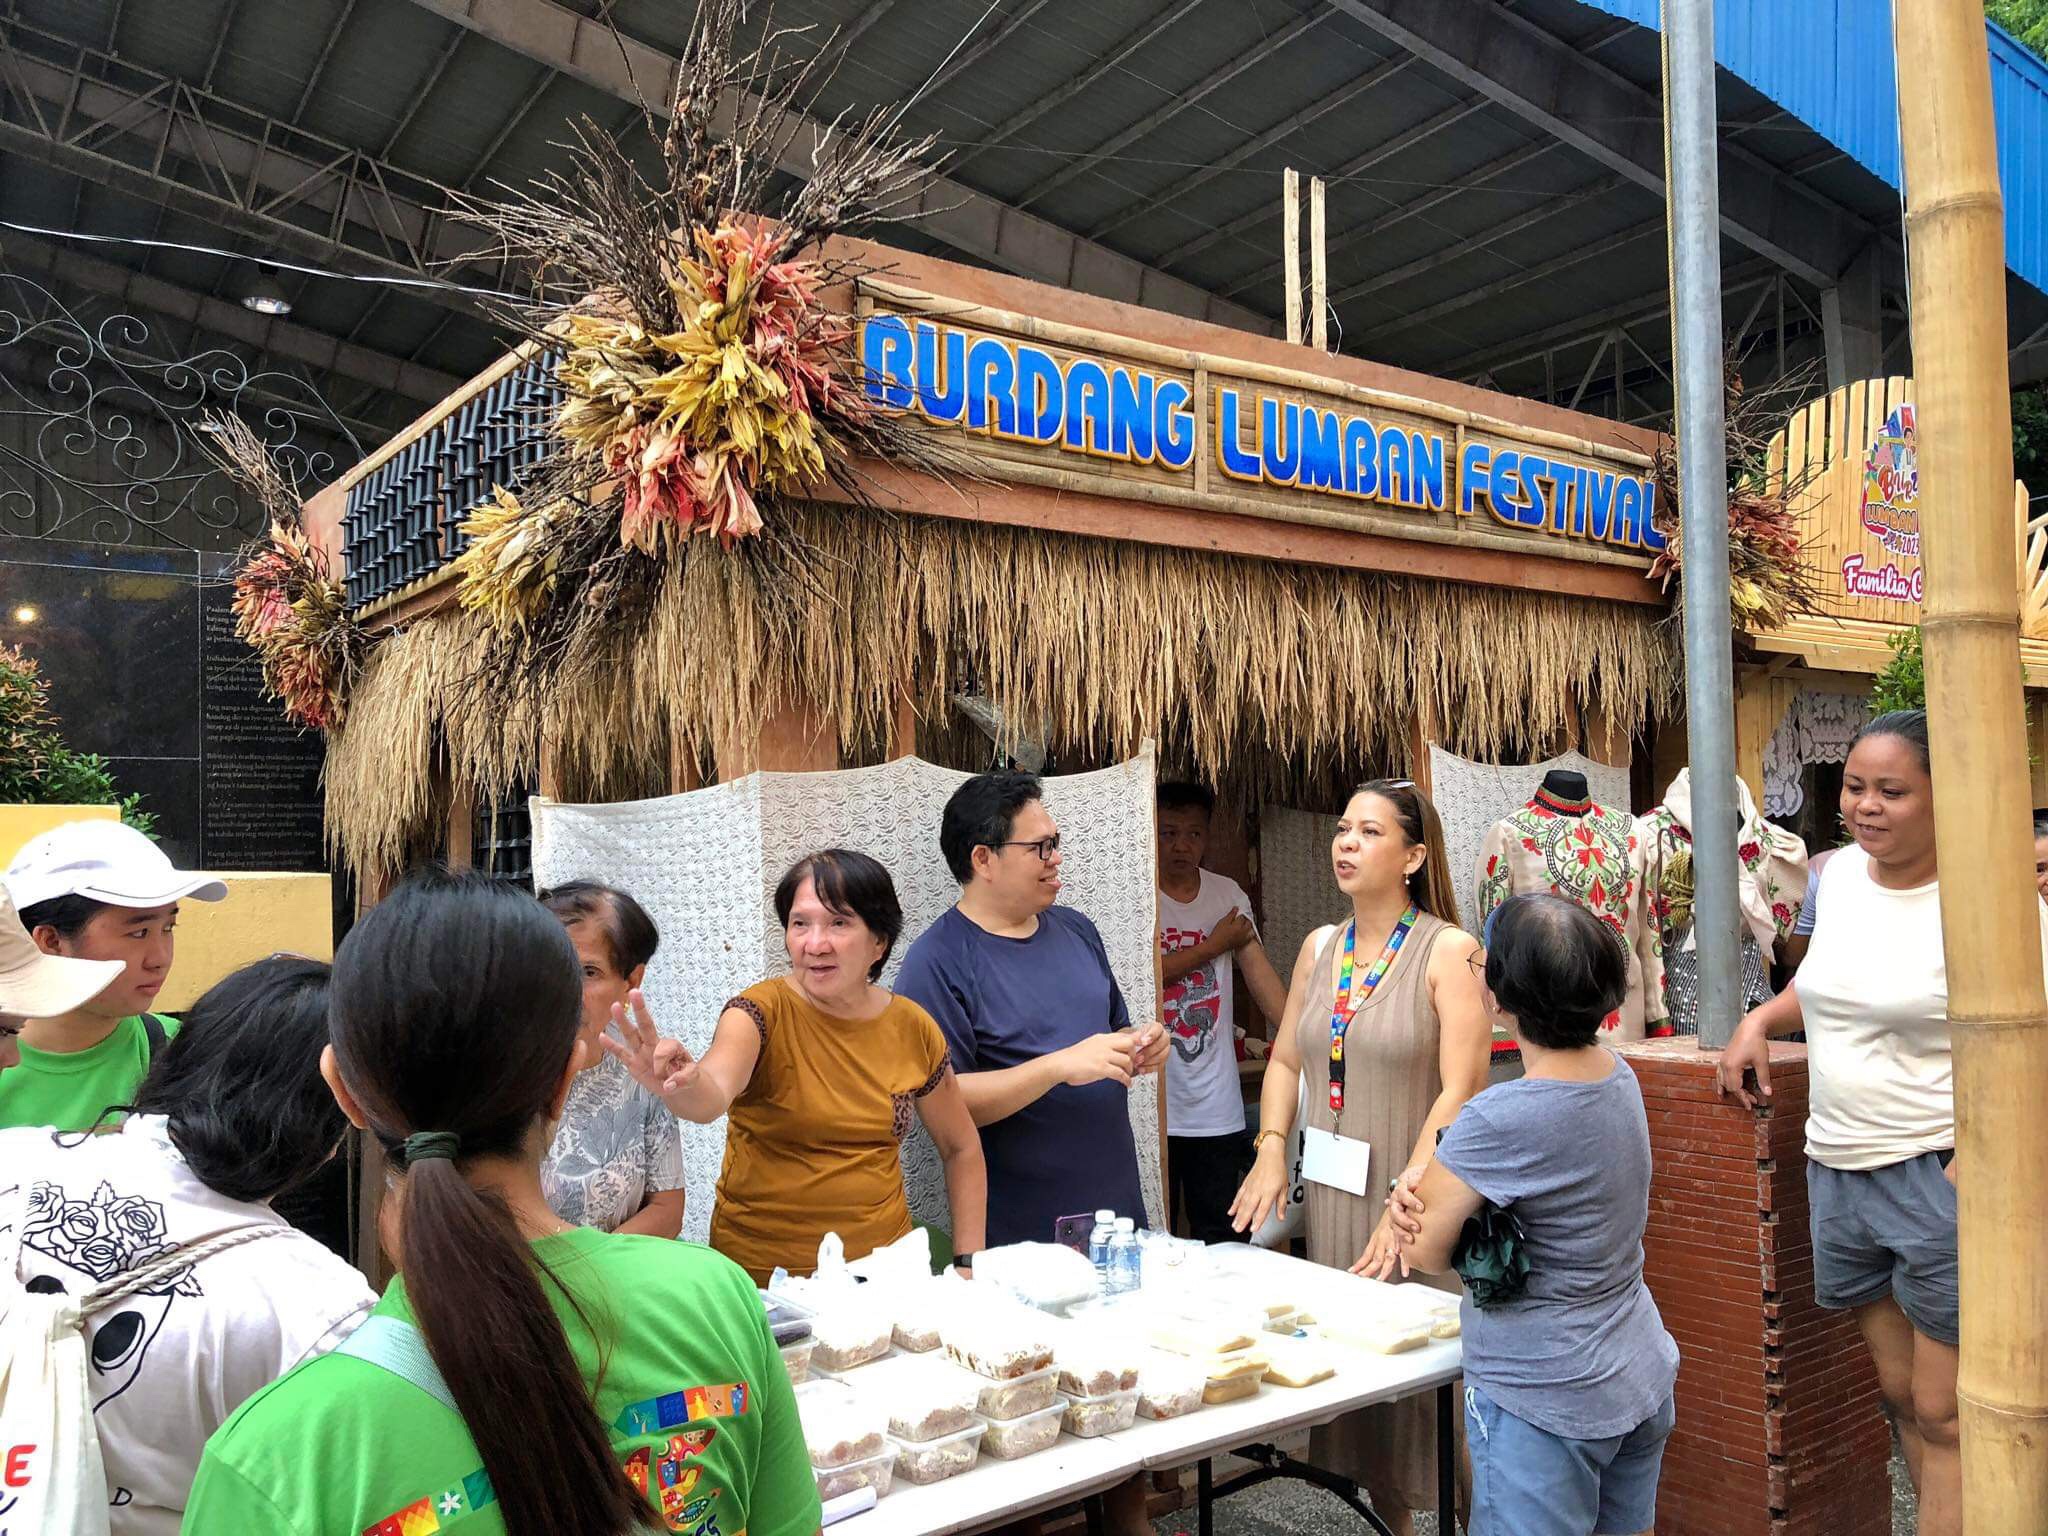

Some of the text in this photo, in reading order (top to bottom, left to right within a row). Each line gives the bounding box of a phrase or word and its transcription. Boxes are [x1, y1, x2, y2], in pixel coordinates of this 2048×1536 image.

[858, 313, 1667, 551] BURDANG LUMBAN FESTIVAL
[1843, 555, 1910, 600] Familia
